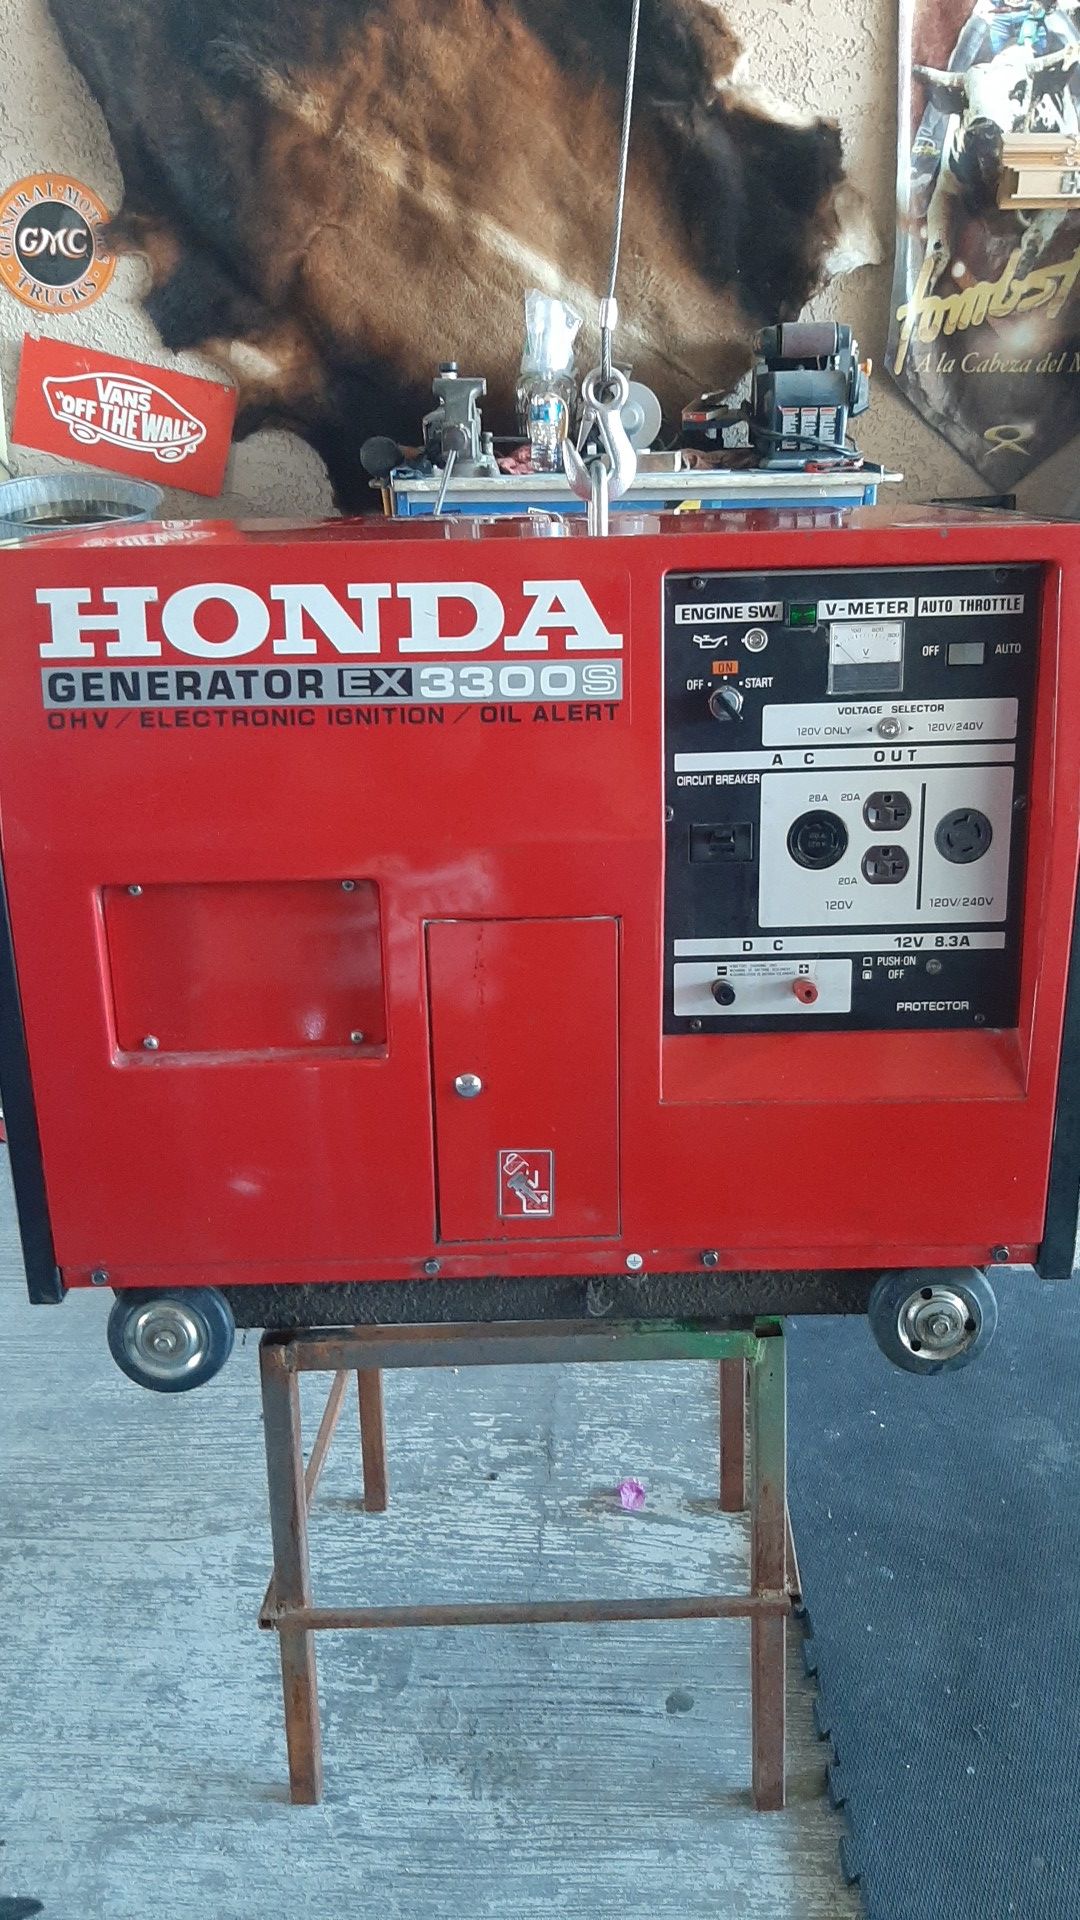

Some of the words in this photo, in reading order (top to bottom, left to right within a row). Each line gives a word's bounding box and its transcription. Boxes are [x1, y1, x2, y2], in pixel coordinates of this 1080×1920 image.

[0, 182, 54, 258] GENERAL
[19, 227, 88, 258] GMC
[17, 271, 97, 306] TRUCKS
[914, 353, 932, 373] A
[936, 352, 956, 373] la
[961, 352, 1032, 373] Cabeza
[1036, 352, 1066, 373] del
[96, 378, 153, 412] VANS
[101, 402, 141, 440] THE
[826, 601, 909, 616] V-METER
[920, 600, 953, 613] AUTO
[959, 598, 1021, 612] THROTTLE
[35, 580, 624, 659] HONDA
[681, 606, 743, 621] ENGINE
[922, 644, 940, 657] OFF
[995, 643, 1022, 655] AUTO
[718, 662, 733, 673] ON
[47, 668, 324, 703] GENERATOR
[342, 669, 410, 696] EX
[419, 664, 618, 698] 3300S
[686, 679, 704, 691] OFF
[744, 676, 774, 689] START
[327, 706, 445, 726] IGNITION
[479, 704, 522, 724] OIL
[532, 703, 620, 723] ALERT
[837, 705, 883, 716] VOLTAGE
[891, 703, 945, 714] SELECTOR
[797, 727, 821, 736] 120V
[823, 726, 852, 736] ONLY
[927, 721, 984, 733] 120V/240V
[676, 774, 714, 787] CIRCUIT
[715, 773, 760, 786] BREAKER
[840, 793, 861, 802] 20A
[838, 876, 858, 886] 20A
[825, 900, 853, 911] 120V
[930, 896, 994, 908] 120V/240V
[893, 936, 924, 949] 12V
[934, 935, 971, 948] 8.3A
[887, 969, 905, 980] OFF
[895, 1000, 970, 1012] PROTECTOR
